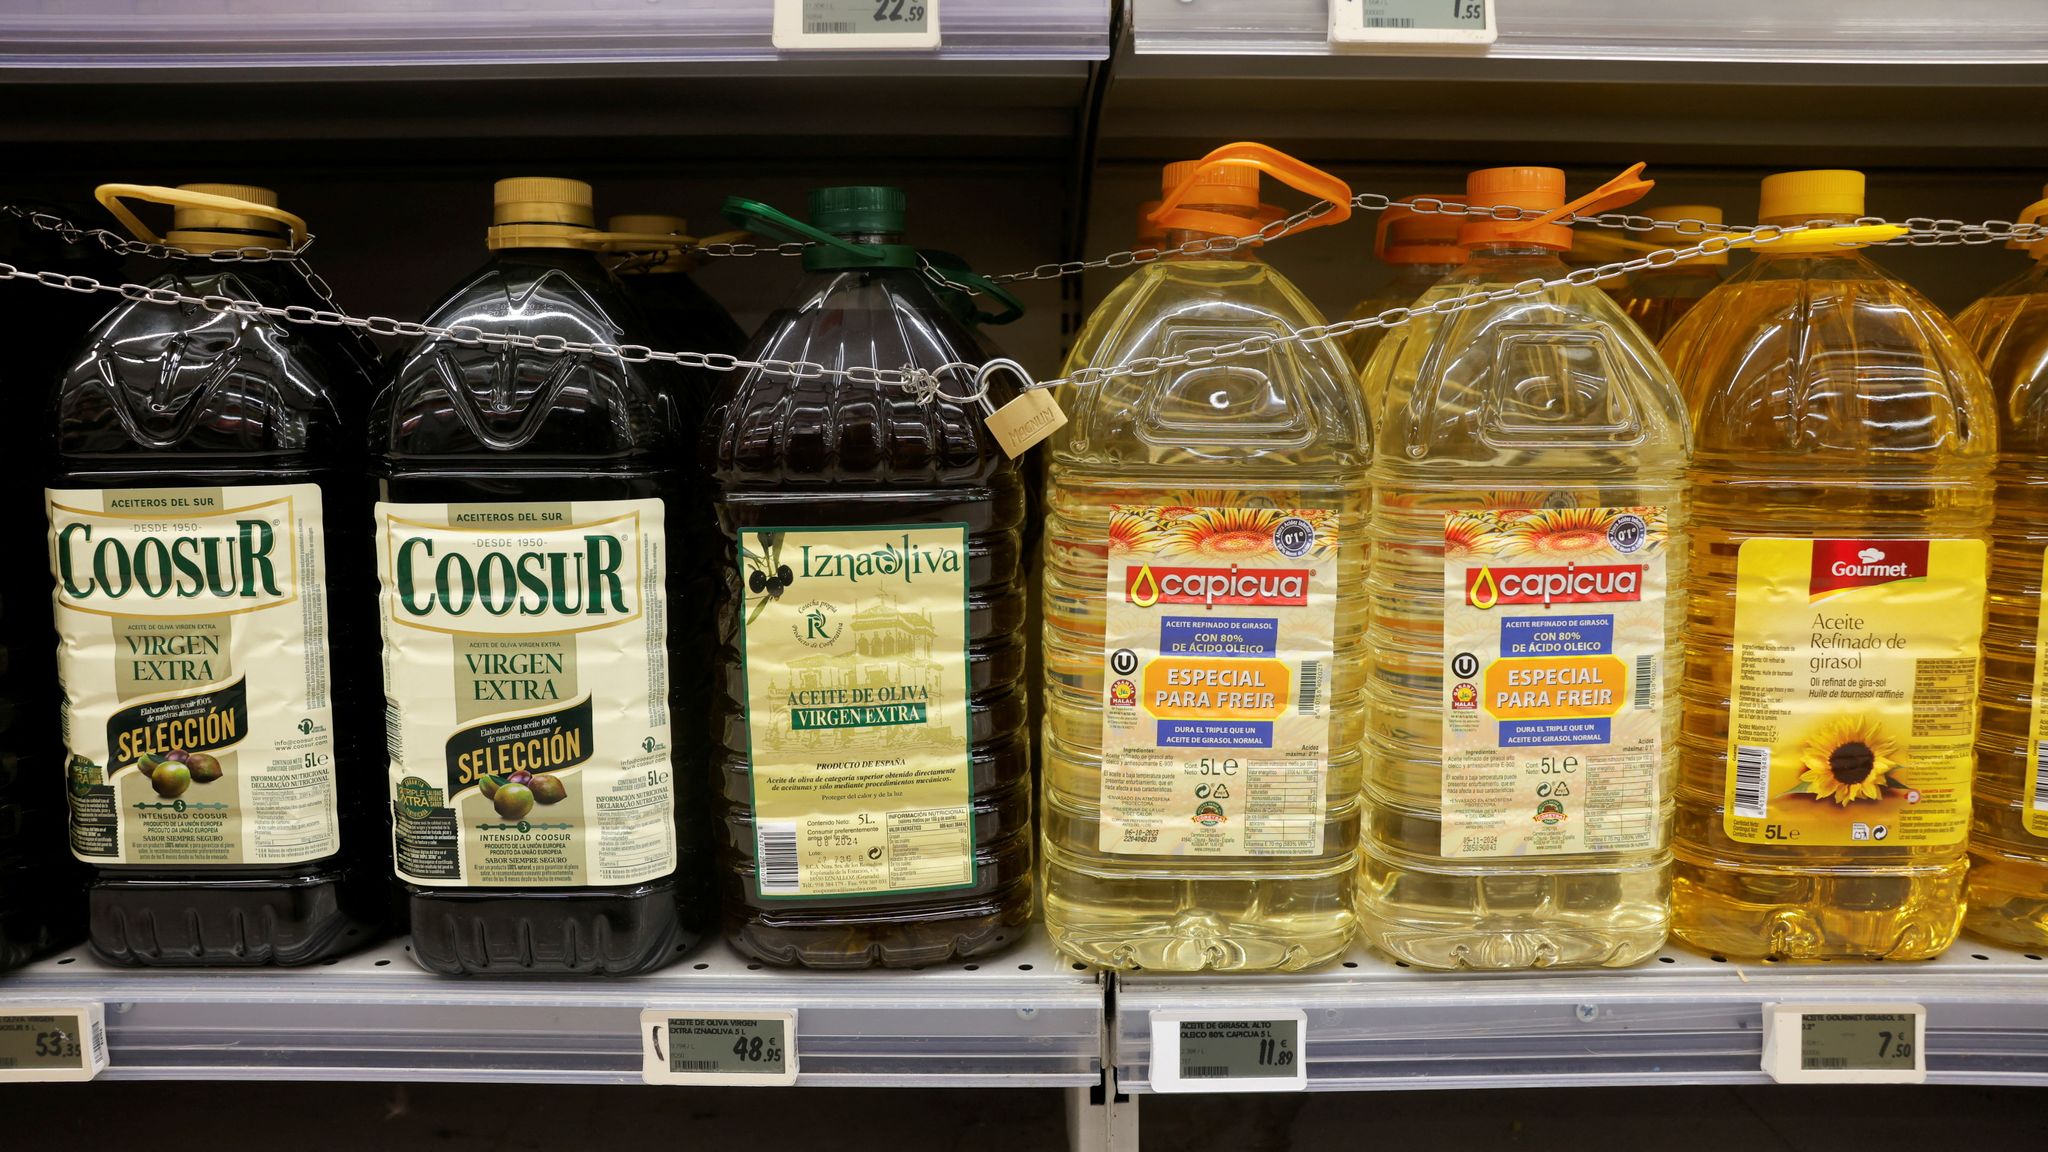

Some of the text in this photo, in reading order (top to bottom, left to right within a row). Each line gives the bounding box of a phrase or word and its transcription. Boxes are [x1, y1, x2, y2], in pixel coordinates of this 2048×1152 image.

[1008, 407, 1054, 448] MAGNUM
[111, 497, 215, 508] ACEITEROS DEL SUR
[456, 512, 563, 522] ACEITEROS DEL SUR
[1831, 561, 1908, 578] Gourmet
[1160, 563, 1303, 609] capicua
[1500, 561, 1636, 609] capicua
[1166, 620, 1191, 629] ACEITE
[1192, 621, 1230, 630] REFINADO
[1241, 622, 1273, 630] GIRASOL
[1506, 618, 1609, 629] ACEITE REFINADO DE GIRASOL
[1811, 612, 1865, 631] Aceite
[1194, 633, 1244, 643] CON 80%
[1533, 631, 1581, 642] CON 80%
[1810, 632, 1907, 650] Refinado de
[124, 635, 220, 656] VIRGEN
[1172, 641, 1264, 654] DE ÁCIDO OLEICO
[1512, 641, 1601, 653] DE ÁCIDO OLEICO
[464, 653, 564, 675] VIRGEN
[1809, 651, 1862, 674] girasol
[133, 660, 214, 681] EXTRA
[1167, 668, 1265, 688] ESPECIAL
[1508, 667, 1603, 687] ESPECIAL
[473, 679, 560, 701] EXTRA
[1810, 677, 1887, 689] Oli refinat de gira-sol
[787, 684, 929, 706] ACEITE DE OLIVA
[1155, 690, 1276, 709] PARA FREIR
[1496, 688, 1613, 709] PARA FREIR
[1808, 689, 1905, 699] Huile de tournesol raffinée
[797, 705, 921, 727] VIRGEN EXTRA
[480, 716, 558, 737] Elaborado con aceite 100%
[1174, 726, 1195, 734] DURA
[1196, 726, 1205, 734] EL
[1205, 726, 1229, 734] TRIPLE
[1229, 726, 1244, 735] QUE
[1516, 724, 1595, 734] DURA EL TRIPLE QUE UN
[117, 706, 236, 763] SELECCIÓN
[487, 727, 551, 744] de nuestras almazaras
[1166, 736, 1264, 745] ACEITE DE GIRASOL NORMAL
[1507, 734, 1602, 744] ACEITE DE GIRASOL NORMAL
[458, 726, 580, 784] SELECCIÓN
[816, 758, 906, 770] PRODUCTO DE ESPAÑA
[766, 768, 957, 784] Aceite de oliva de categoría superior obtenido directamente
[781, 783, 813, 791] aceitunas
[819, 782, 833, 790] sólo
[834, 780, 864, 789] mediante
[865, 778, 915, 790] procedimientos
[916, 776, 952, 785] mecánicos.
[138, 812, 228, 820] INTENSIDAD COOSUR
[858, 813, 875, 825] 5L.
[480, 834, 531, 842] INTENSIDAD
[835, 837, 858, 846] 2024
[670, 1019, 758, 1027] ACEITE DE OLIVA VIRGEN
[1180, 1031, 1207, 1039] OLEICO
